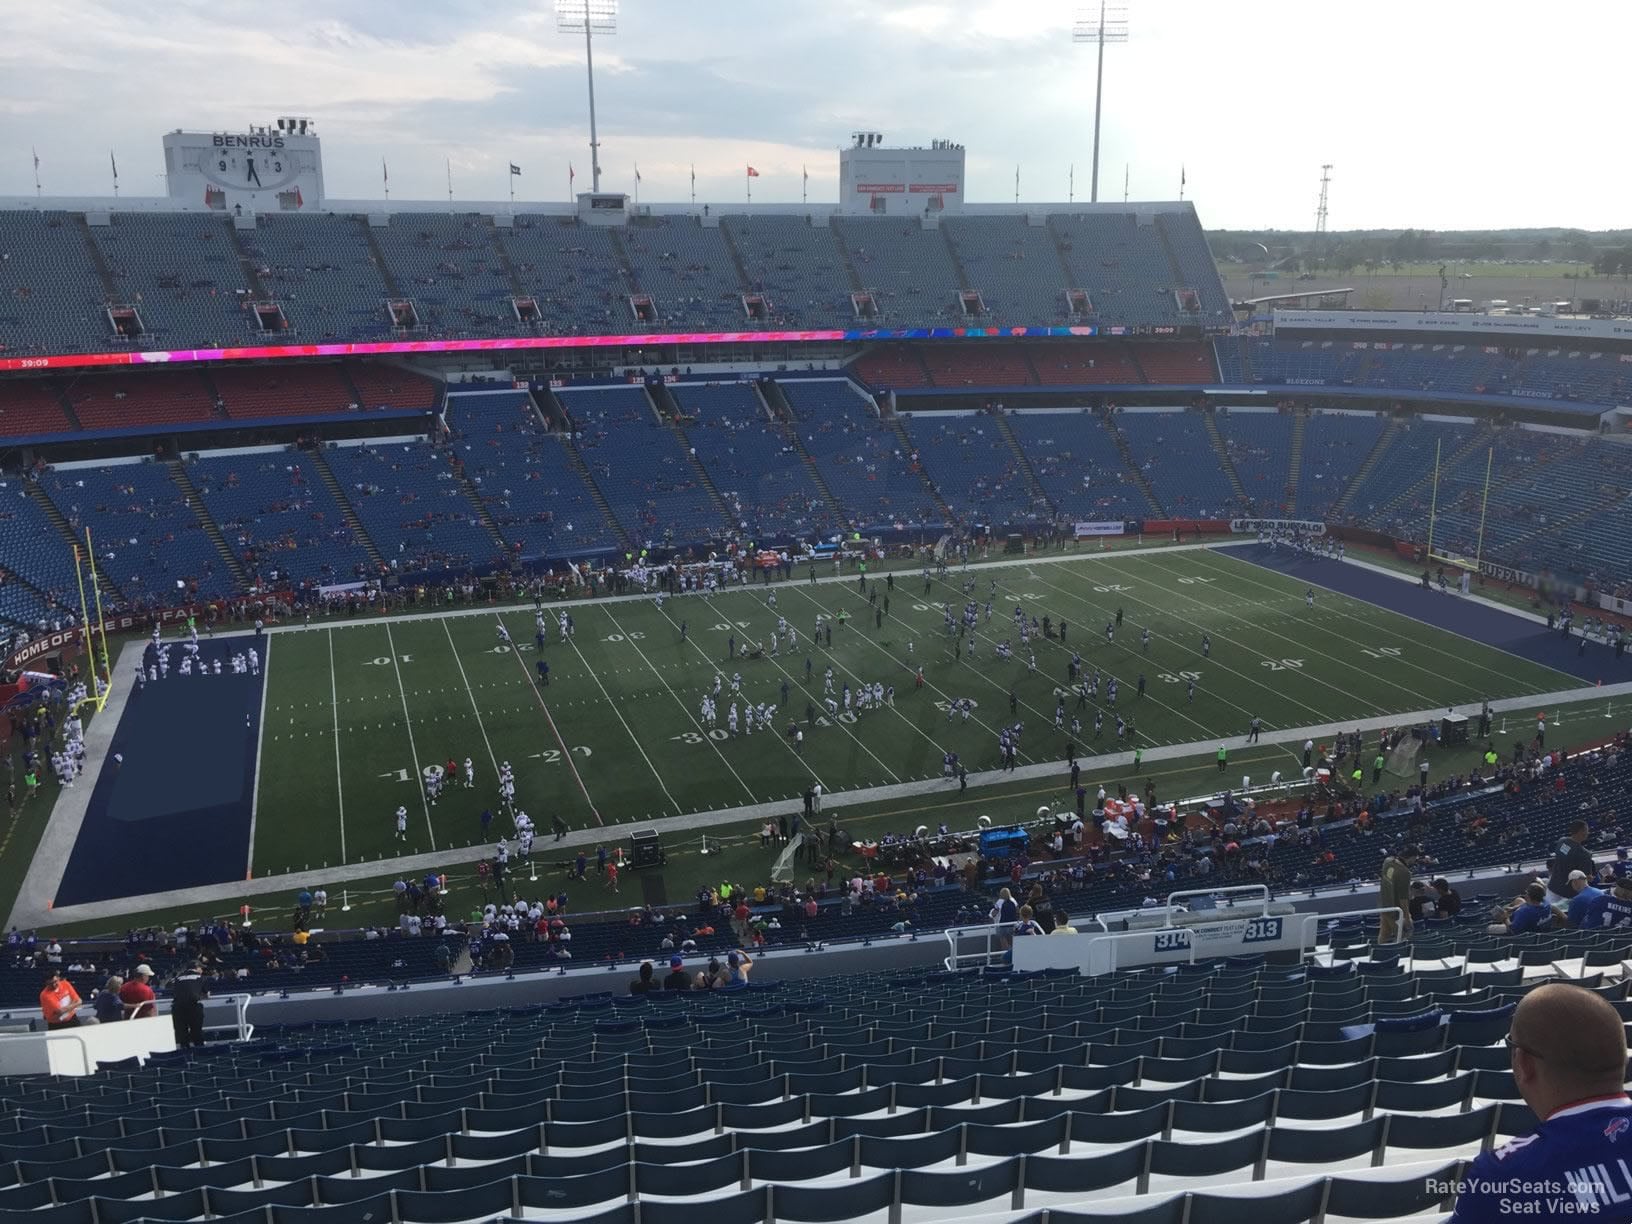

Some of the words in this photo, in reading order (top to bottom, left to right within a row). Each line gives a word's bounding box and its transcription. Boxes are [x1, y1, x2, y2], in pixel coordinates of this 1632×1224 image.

[213, 136, 285, 148] BENRUS
[219, 160, 227, 172] 9
[275, 161, 282, 173] 3
[21, 359, 49, 368] 39:09
[15, 640, 49, 665] HOME
[51, 632, 73, 646] OF
[79, 621, 115, 637] THE
[681, 729, 729, 744] 30
[1246, 921, 1277, 939] 313
[1157, 932, 1189, 948] 314
